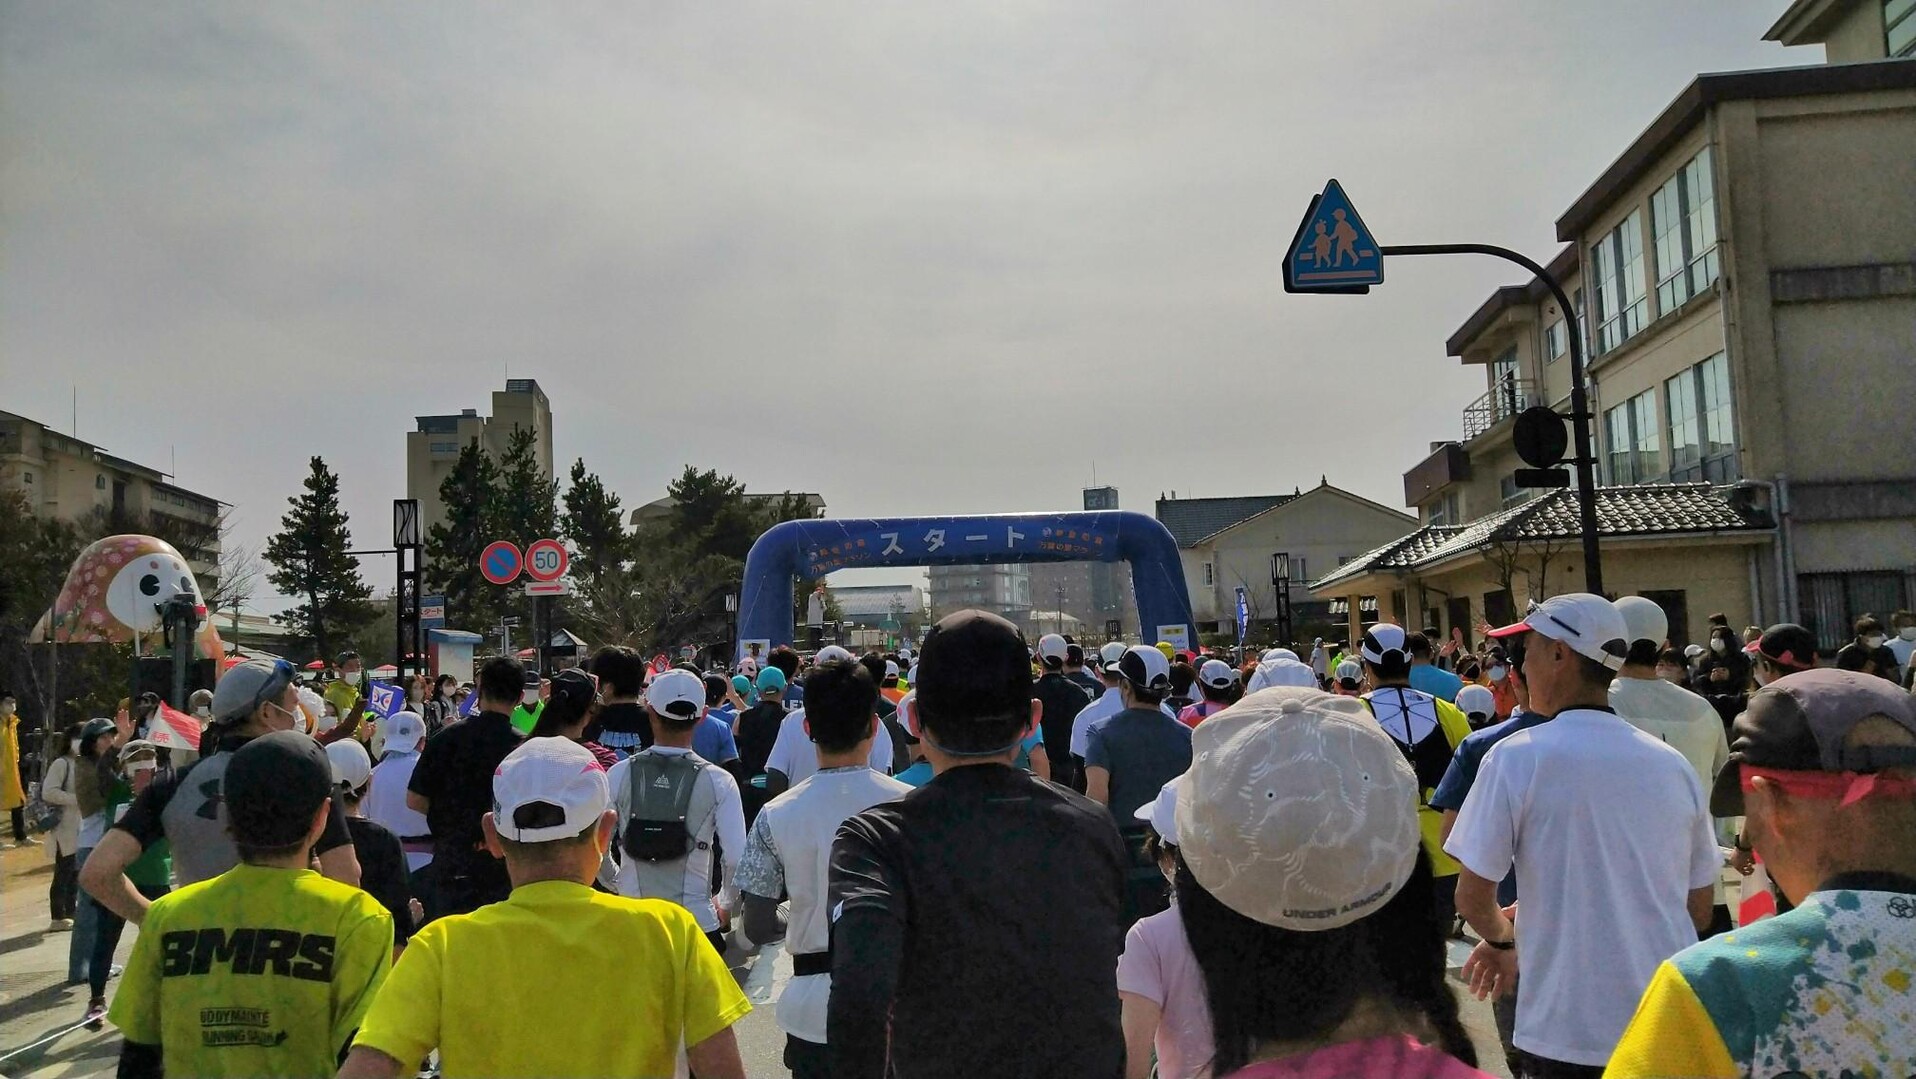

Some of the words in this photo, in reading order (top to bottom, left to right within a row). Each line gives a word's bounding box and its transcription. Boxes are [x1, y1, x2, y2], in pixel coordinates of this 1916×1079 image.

[880, 525, 1025, 557] スタート
[535, 551, 557, 569] 50
[1282, 908, 1337, 919] UNDER
[1340, 881, 1392, 914] ARMOUR
[162, 928, 336, 983] BMRS
